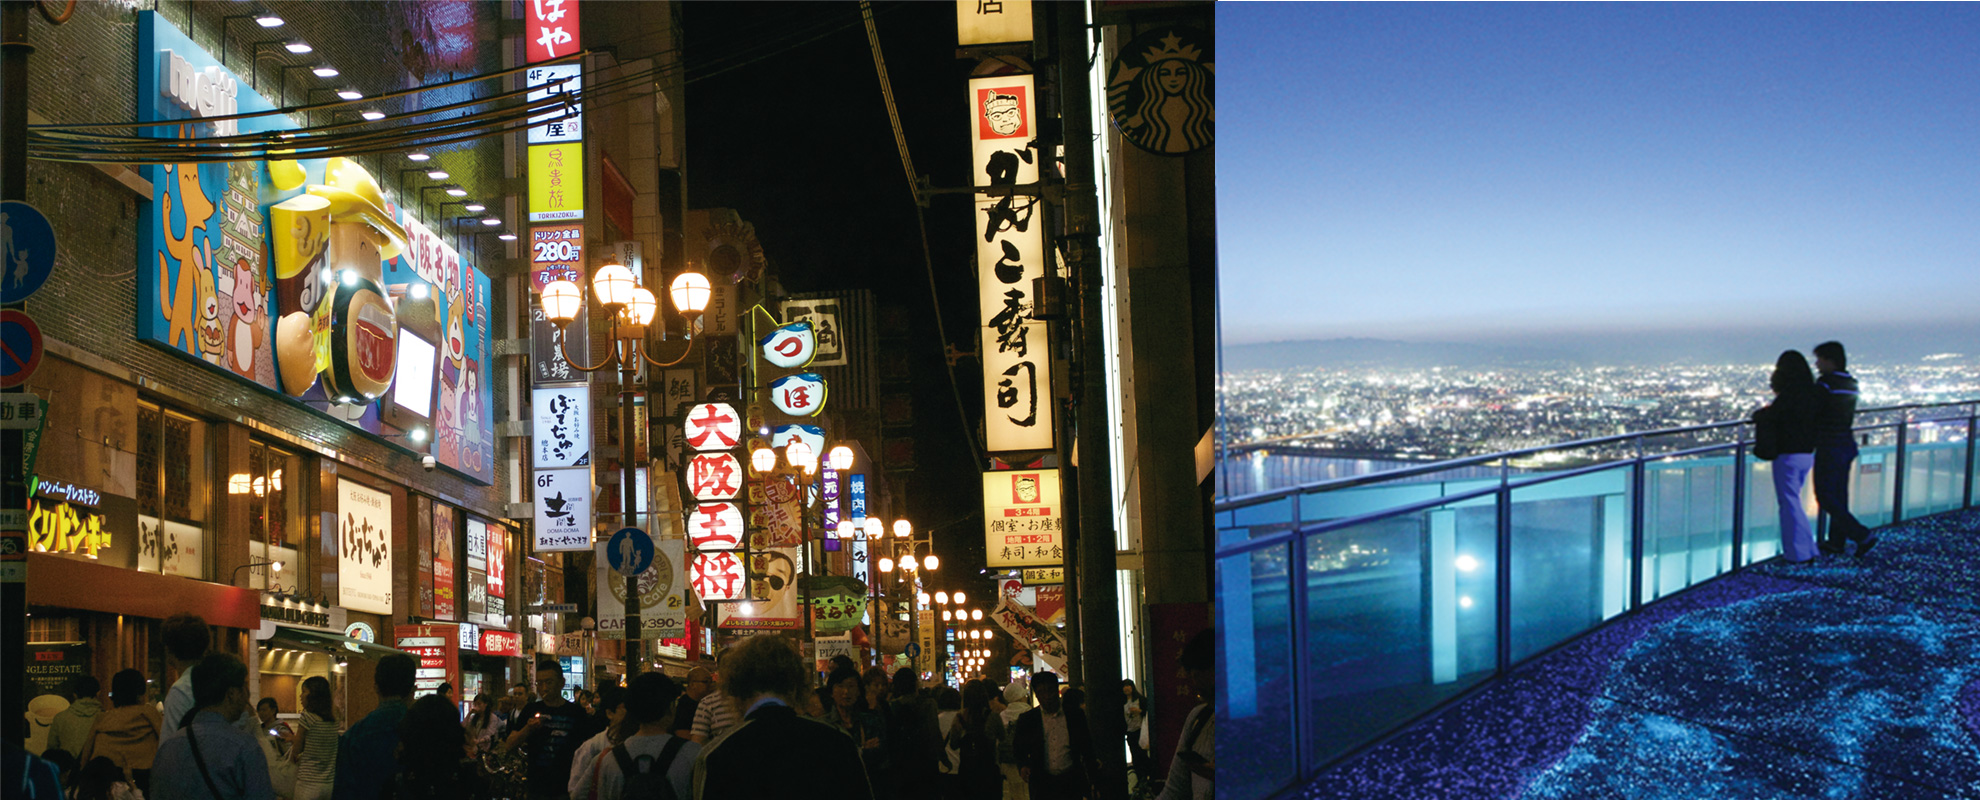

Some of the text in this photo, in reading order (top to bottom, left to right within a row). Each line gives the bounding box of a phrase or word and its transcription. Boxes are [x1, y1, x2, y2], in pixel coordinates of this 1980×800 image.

[529, 70, 542, 81] 4F
[160, 48, 238, 147] meiji
[538, 211, 575, 219] TORIKIZOKU
[982, 138, 1039, 427] がんこ寿司
[550, 320, 570, 379] 内農場
[537, 474, 553, 487] 6F
[38, 480, 100, 506] ハンバーグレストラン
[686, 403, 740, 599] 大阪王将
[342, 512, 388, 568] ぼてぢゅう
[1000, 545, 1062, 560] 寿司・和食
[1025, 569, 1064, 580] 個室・和
[668, 597, 682, 607] 2F
[1037, 593, 1063, 602] ドラッグ
[818, 648, 852, 658] PIZZA
[49, 665, 82, 674] ESTATE
